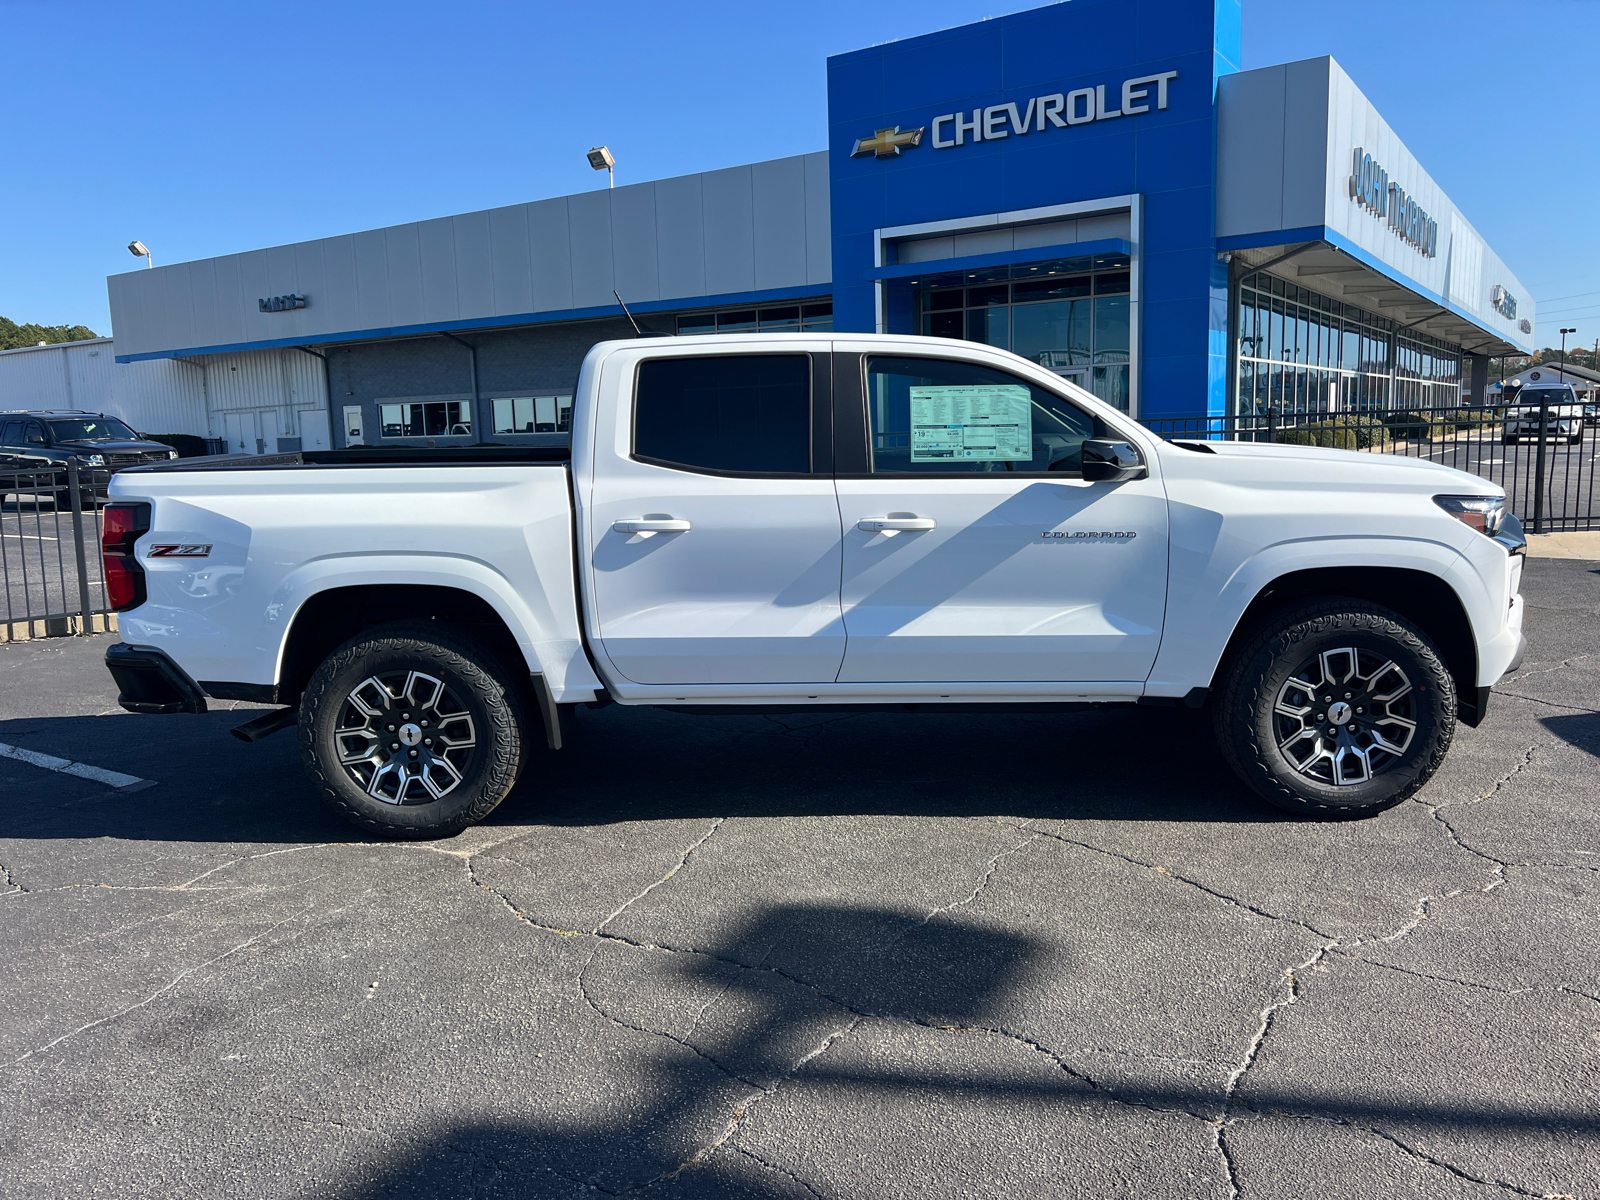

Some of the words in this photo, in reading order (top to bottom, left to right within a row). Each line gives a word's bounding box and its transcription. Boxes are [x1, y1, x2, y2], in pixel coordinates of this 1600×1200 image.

[931, 70, 1179, 149] CHEVROLET
[1349, 147, 1388, 217] JOHN
[1388, 182, 1437, 257] THORNTON
[259, 294, 298, 312] PARTS
[147, 543, 213, 558] Z71
